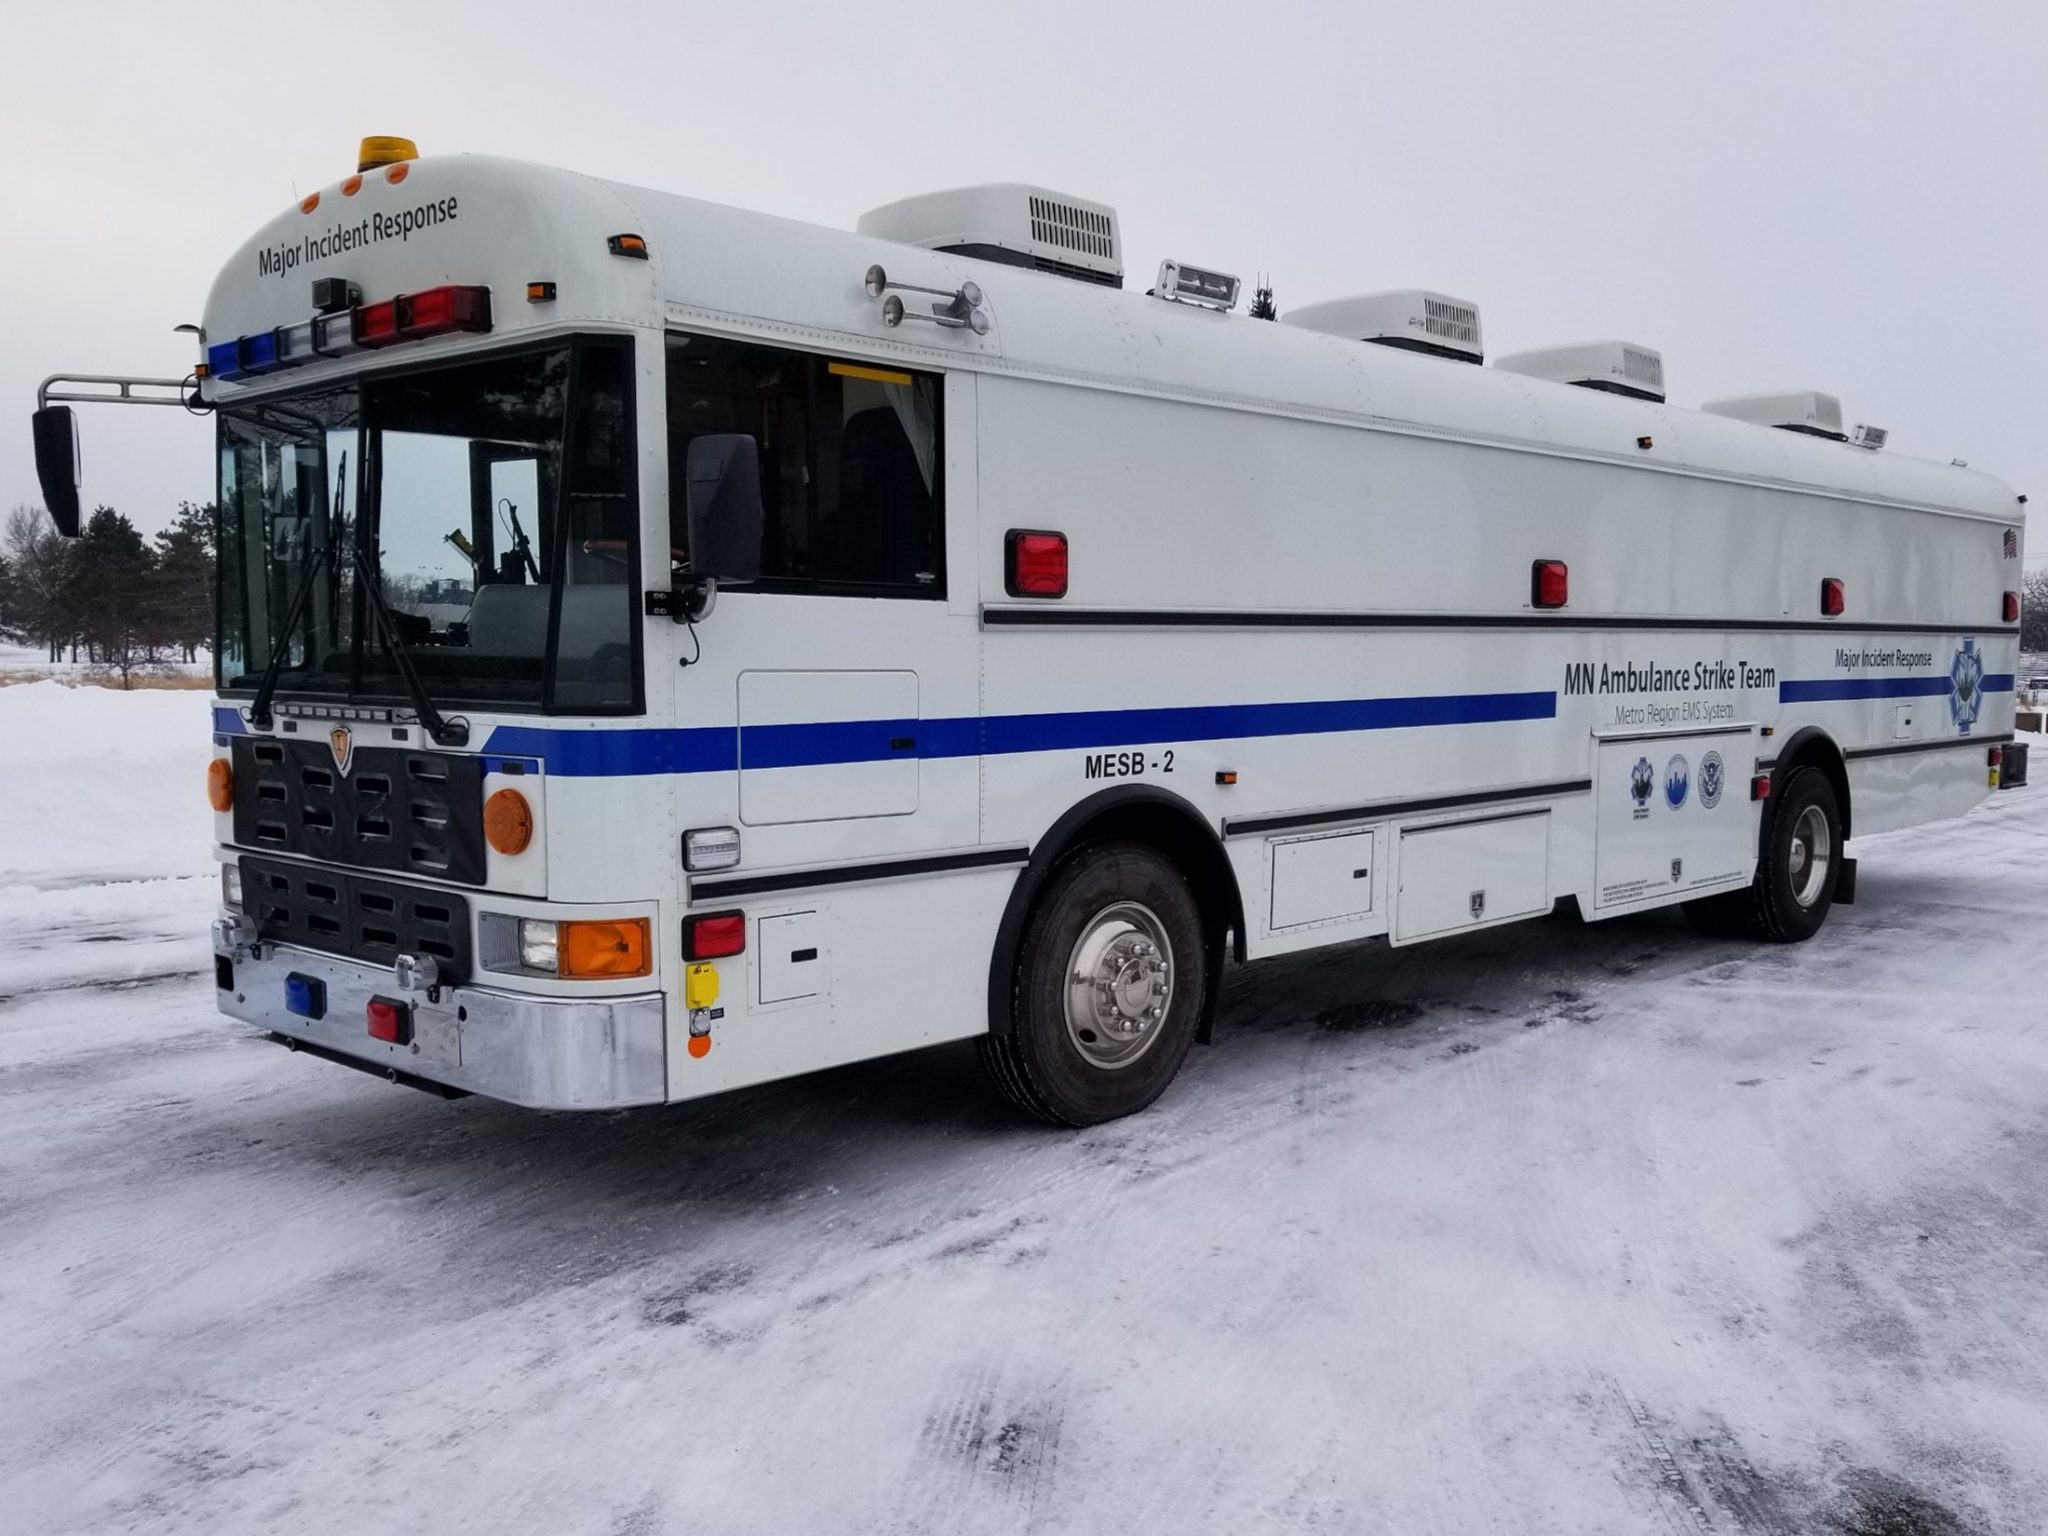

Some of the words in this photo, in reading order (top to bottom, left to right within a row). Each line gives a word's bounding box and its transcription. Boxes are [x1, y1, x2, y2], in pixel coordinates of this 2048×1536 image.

[259, 242, 302, 278] Major
[304, 219, 369, 263] Incident
[372, 196, 458, 242] Response
[1834, 648, 1860, 672] Major
[1861, 648, 1895, 667] Incident
[1896, 648, 1932, 671] Response
[1564, 662, 1595, 695] MN
[1599, 661, 1690, 694] Ambulance
[1694, 660, 1735, 691] Strike
[1739, 661, 1775, 689] Team
[1614, 705, 1645, 724] Metro
[1647, 703, 1680, 726] Region
[1682, 701, 1701, 720] EMS
[1085, 752, 1145, 779] MESB
[1163, 750, 1175, 773] 2
